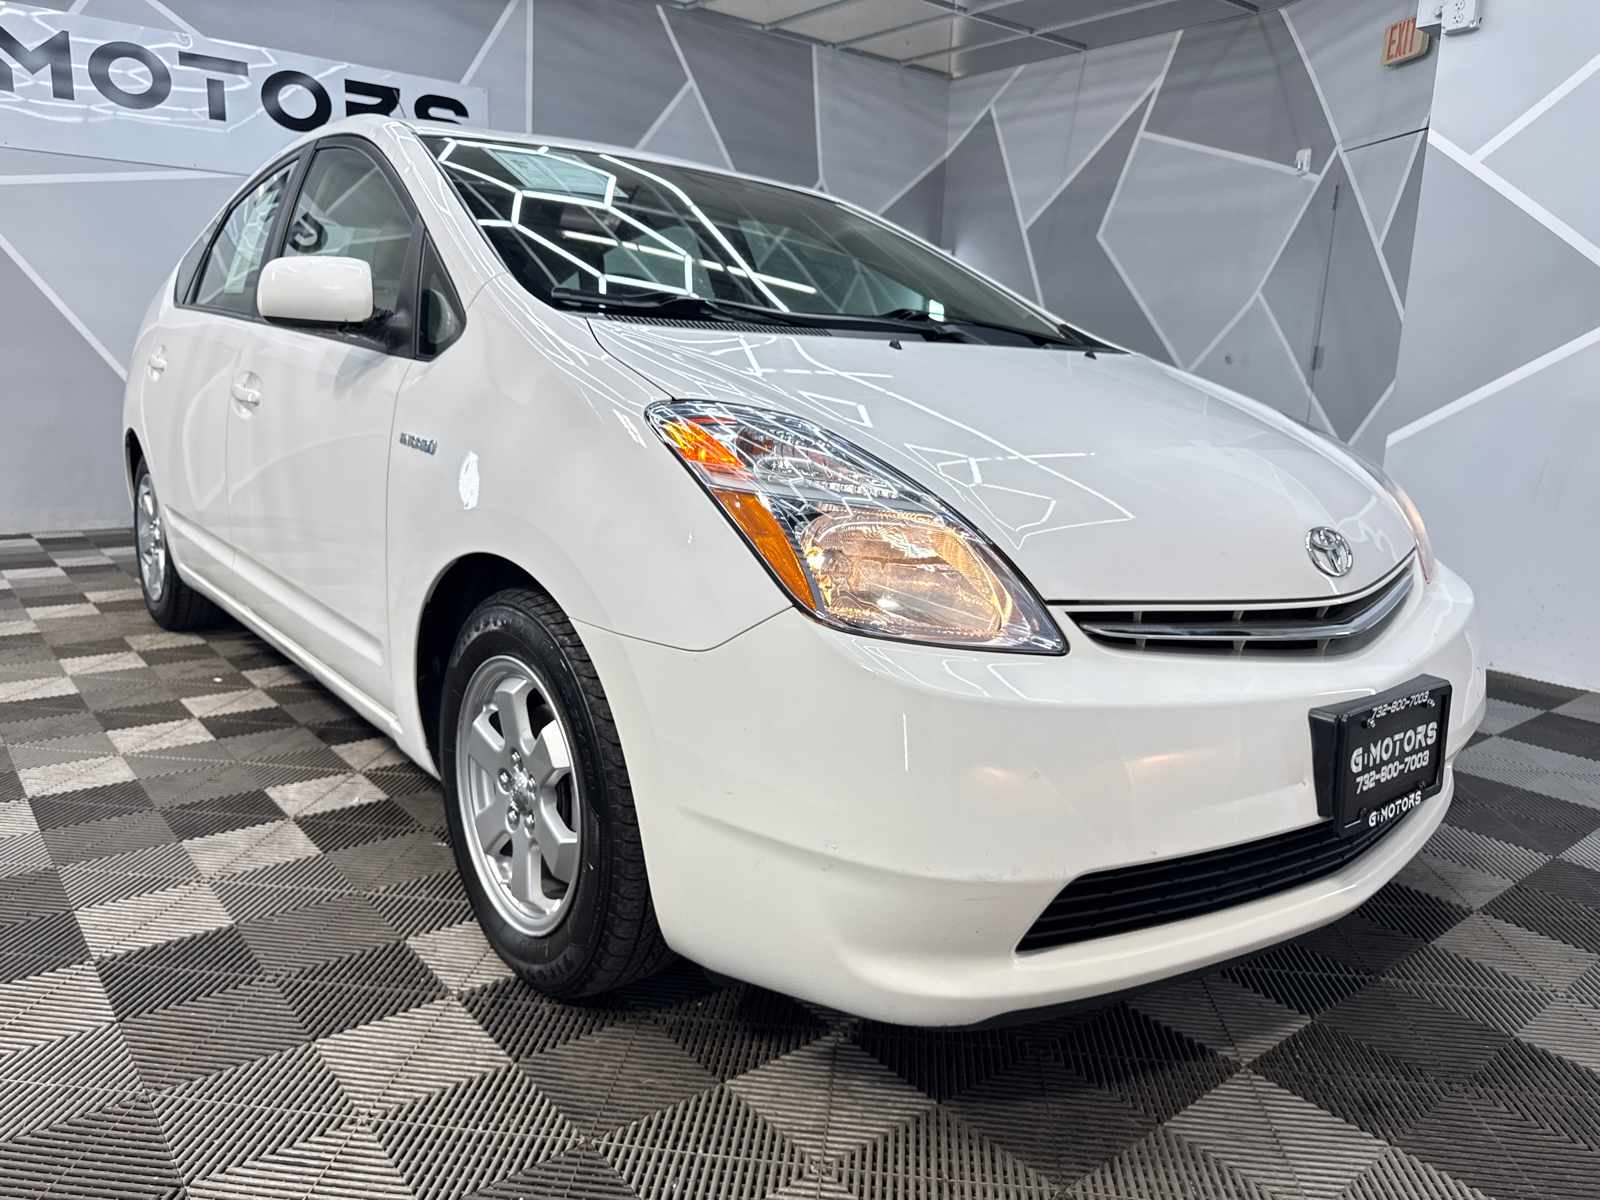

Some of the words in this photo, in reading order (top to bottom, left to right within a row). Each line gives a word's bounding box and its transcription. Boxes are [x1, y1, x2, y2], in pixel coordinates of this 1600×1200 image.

[1386, 17, 1416, 61] EXIT
[1371, 690, 1430, 720] 732-800-7003
[1356, 749, 1430, 795] 732-800-7003
